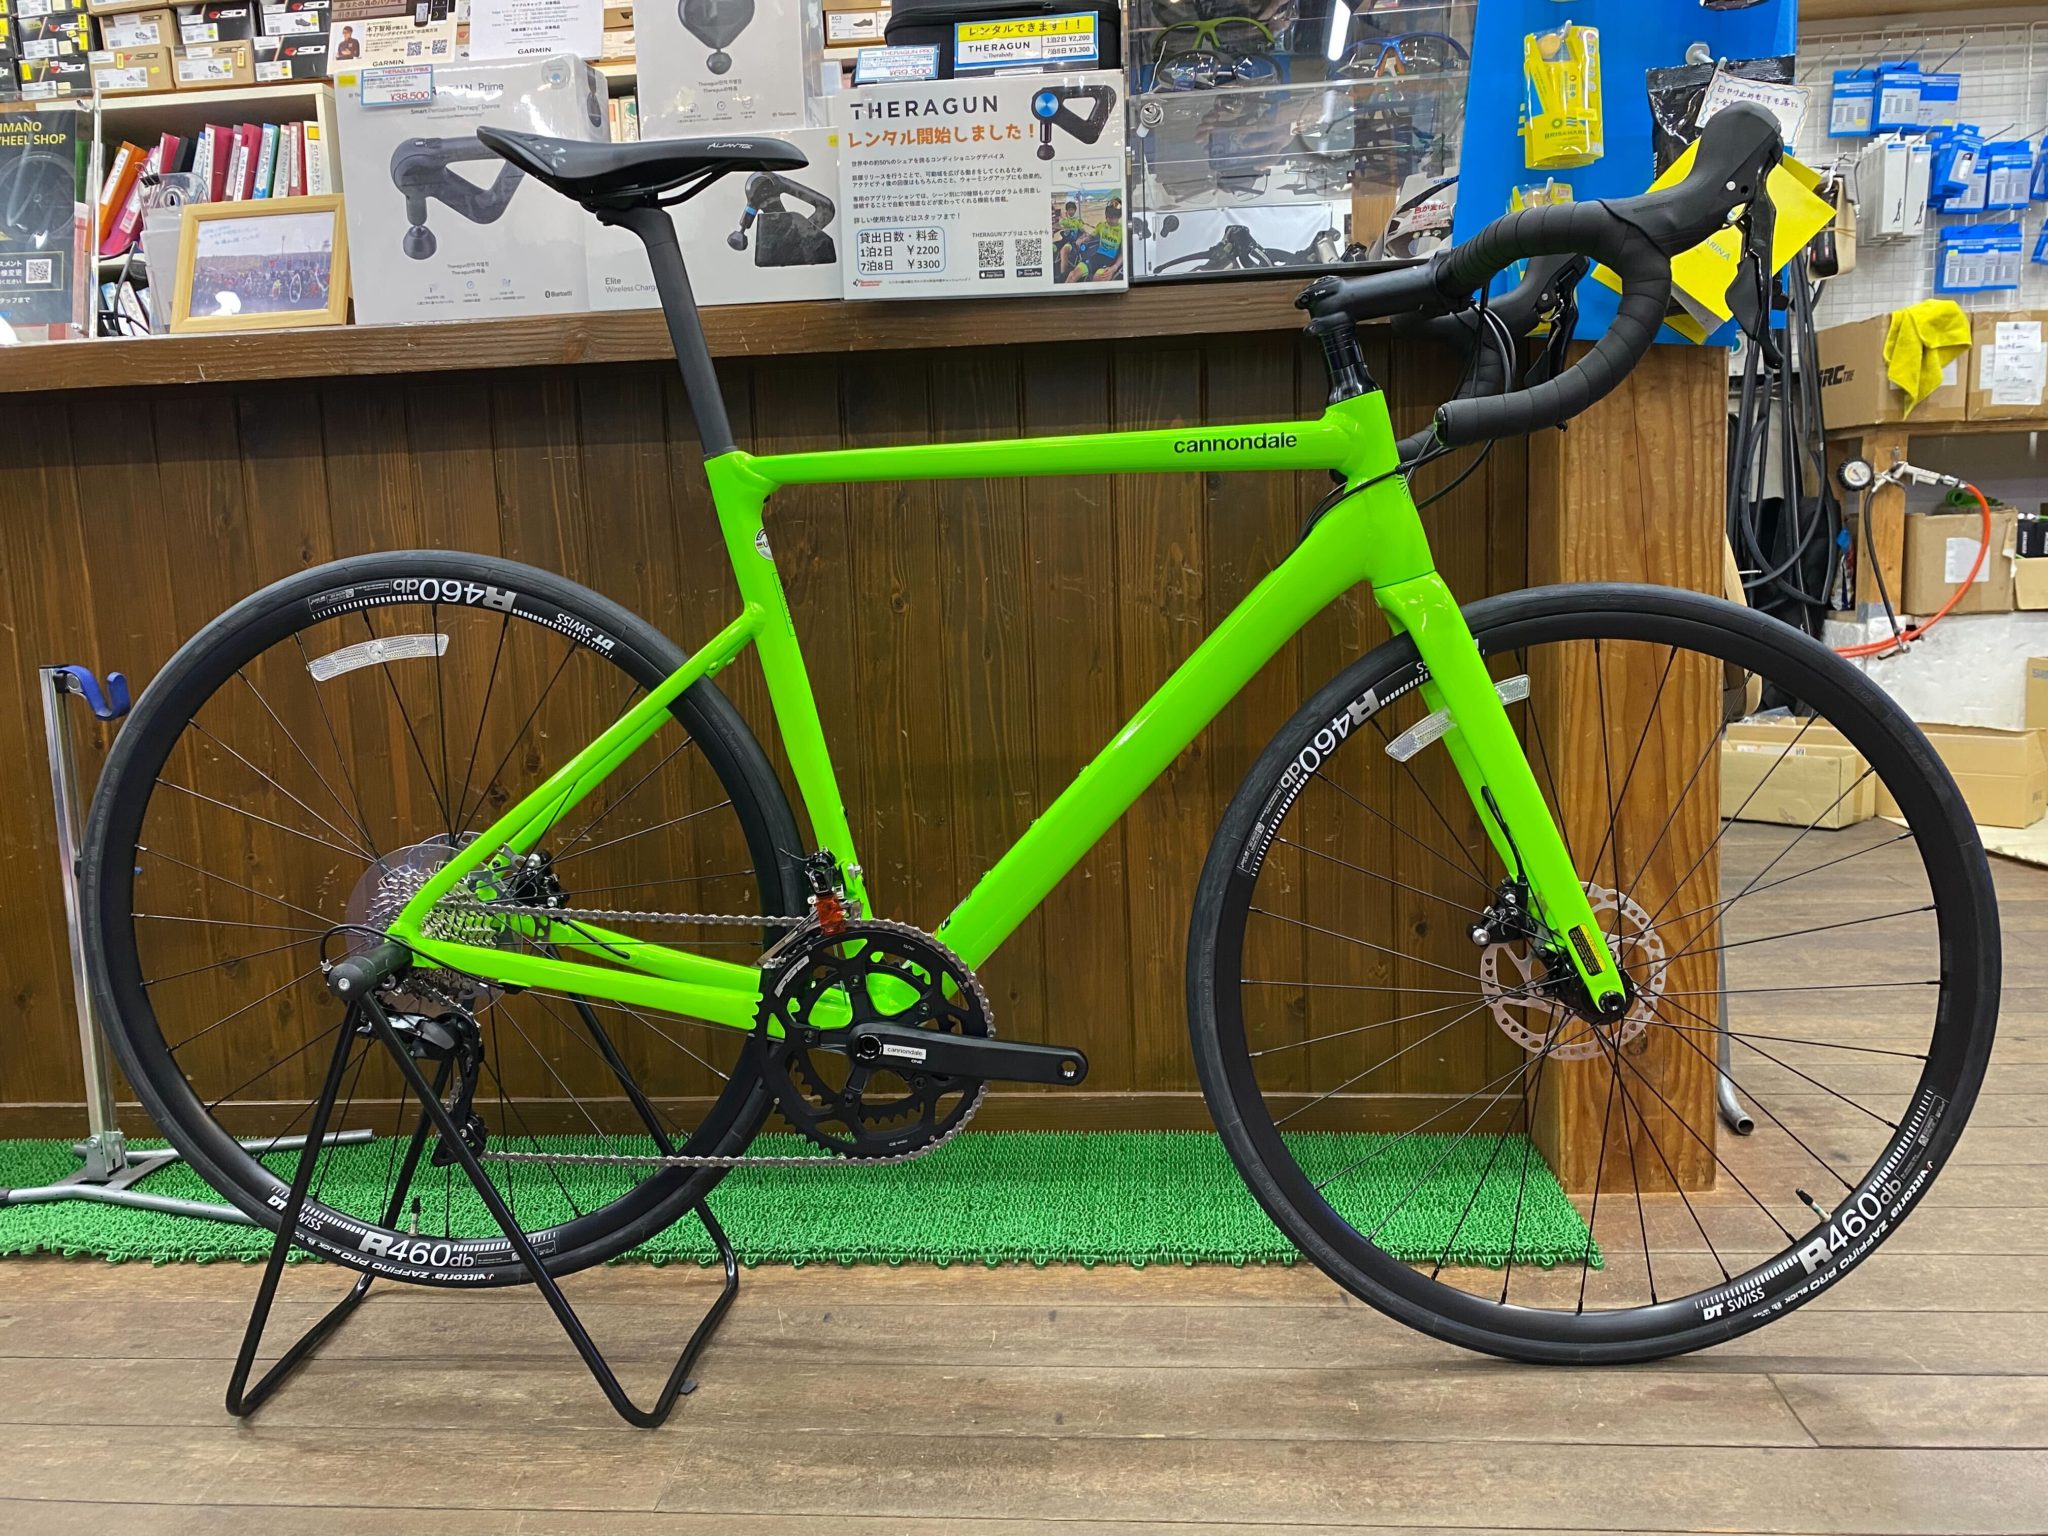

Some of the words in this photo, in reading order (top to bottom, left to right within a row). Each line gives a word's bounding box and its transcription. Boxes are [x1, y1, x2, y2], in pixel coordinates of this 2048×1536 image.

[969, 19, 1081, 36] レンタルできます！！
[518, 47, 552, 55] GARMIN
[968, 41, 1030, 53] THERAGUN
[478, 82, 504, 91] Prime
[850, 95, 998, 120] THERAGUN
[0, 121, 42, 133] IMANO
[33, 133, 66, 145] SHOP
[848, 123, 1034, 148] レンタル開始しました！
[859, 229, 939, 244] 貸出日数・料金
[860, 246, 893, 258] 1泊2日
[860, 260, 893, 271] 7泊8日
[605, 277, 621, 285] Elite
[605, 285, 633, 293] Wireless
[635, 284, 656, 292] Charg
[1174, 432, 1297, 454] cannondale
[555, 613, 593, 637] SWISS
[592, 634, 615, 650] DT
[887, 1046, 923, 1057] cannondale
[298, 1212, 324, 1230] WISS
[1839, 1219, 1889, 1270] ZAFFIRO
[341, 1252, 369, 1267] PRO
[371, 1262, 430, 1279] ZAFFIRO
[1809, 1267, 1838, 1291] PRO
[1703, 1304, 1724, 1320] DT
[1728, 1287, 1766, 1313] SWISS
